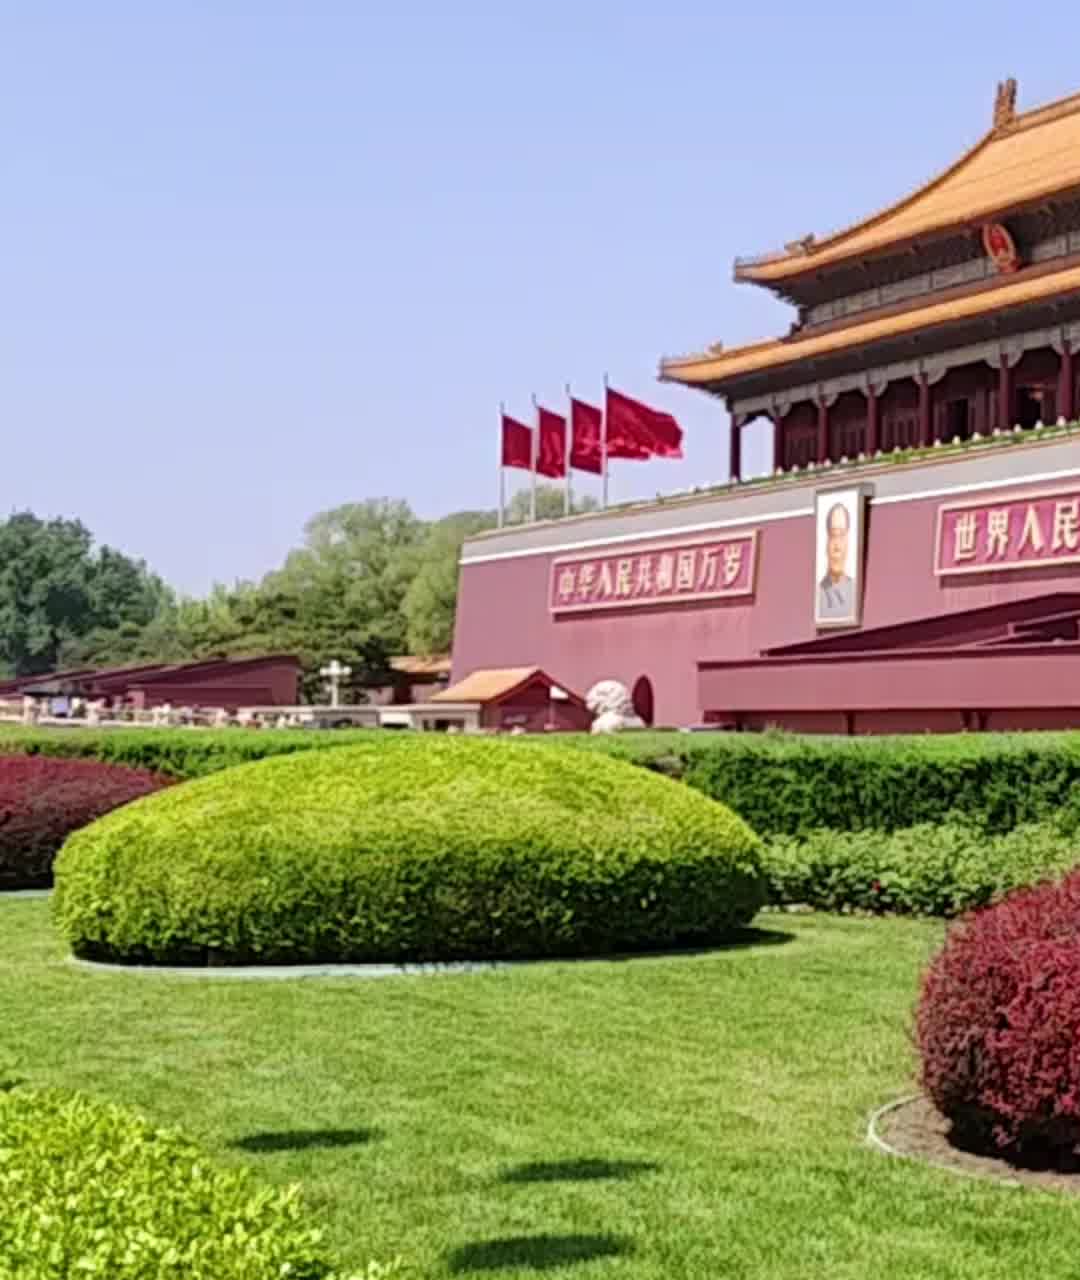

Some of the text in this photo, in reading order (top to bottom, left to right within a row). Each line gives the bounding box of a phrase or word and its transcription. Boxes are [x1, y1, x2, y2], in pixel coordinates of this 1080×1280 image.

[558, 543, 744, 600] 中华人民共和国万岁
